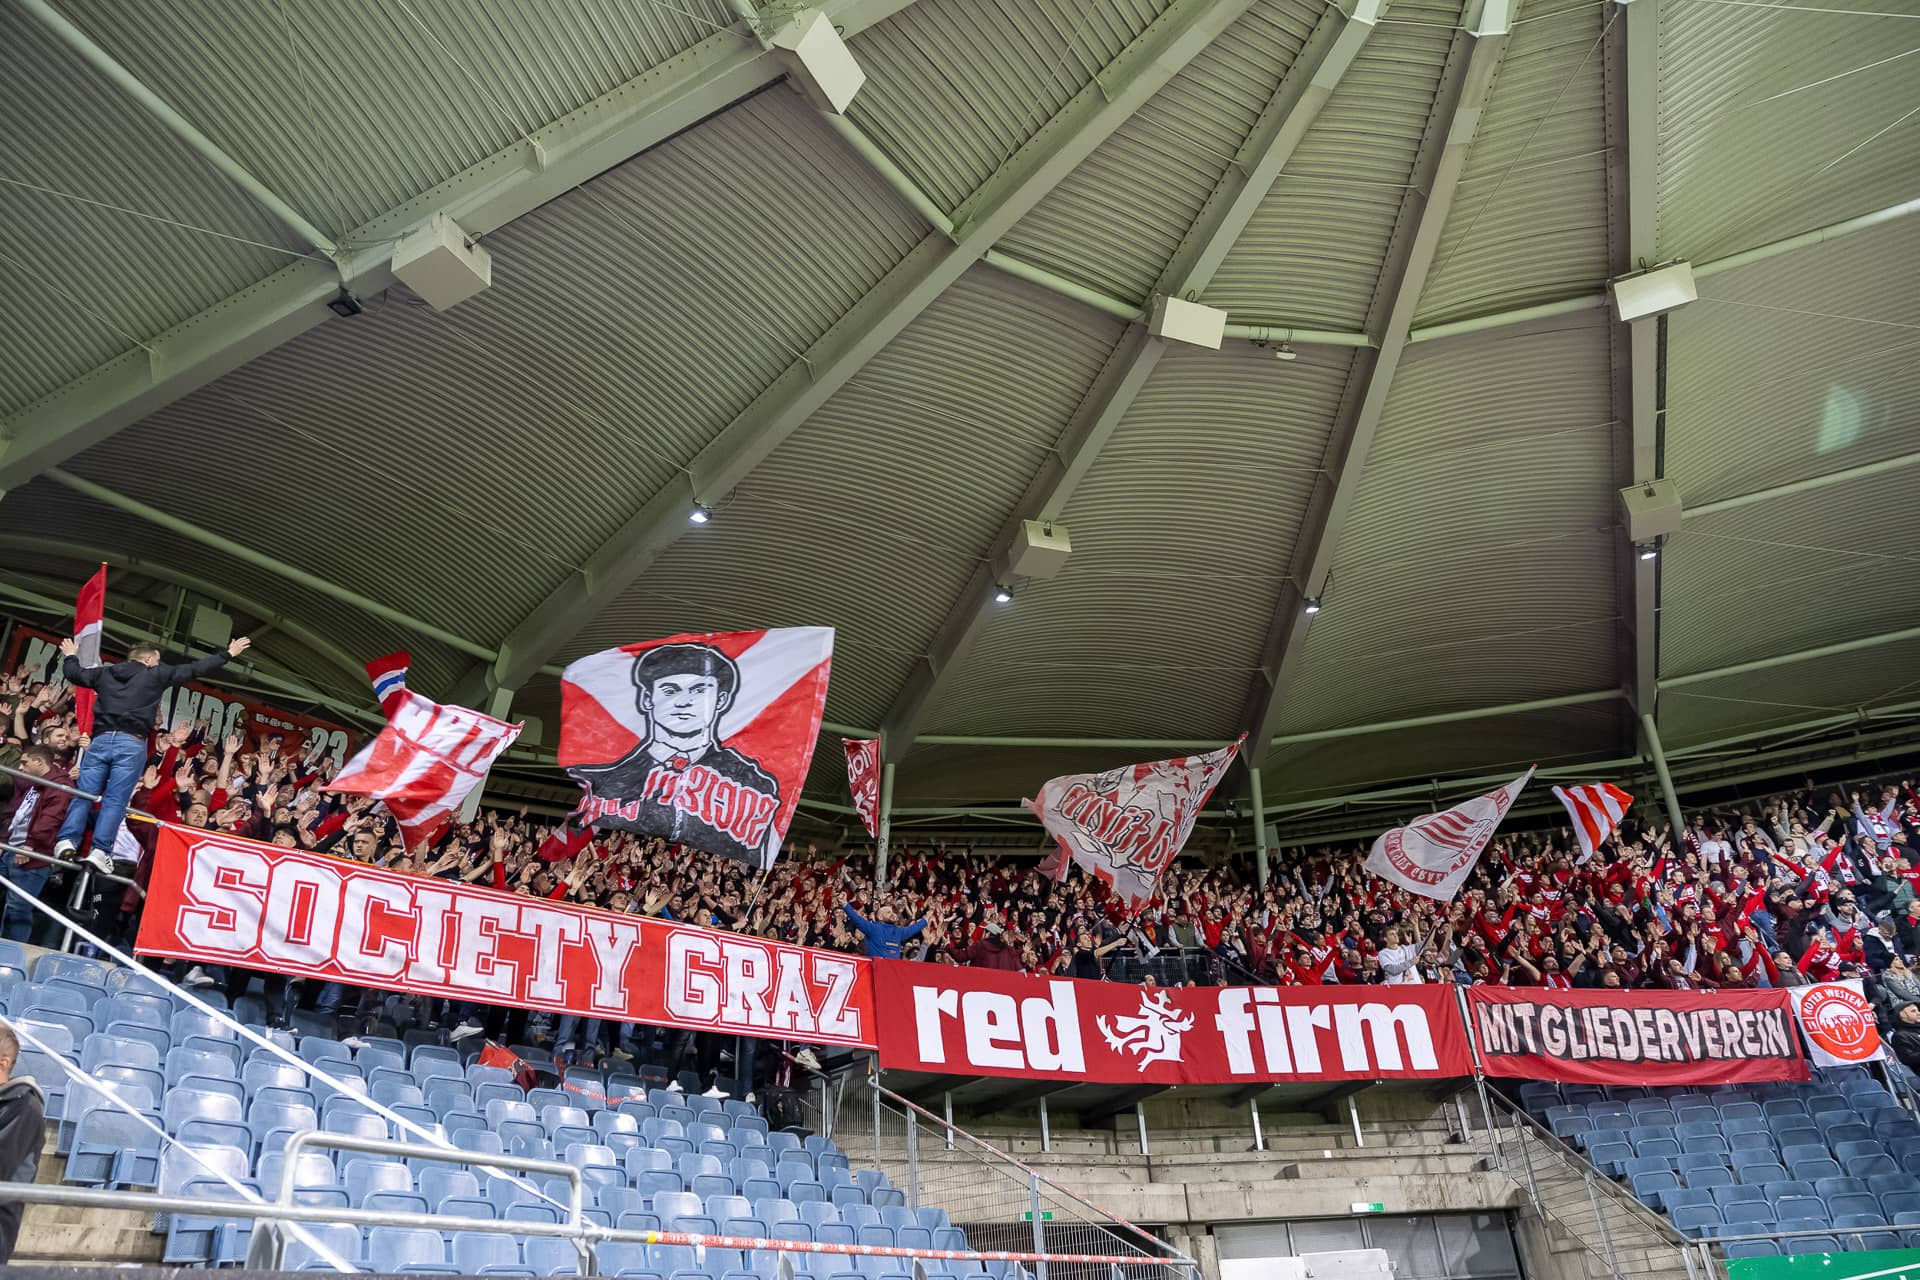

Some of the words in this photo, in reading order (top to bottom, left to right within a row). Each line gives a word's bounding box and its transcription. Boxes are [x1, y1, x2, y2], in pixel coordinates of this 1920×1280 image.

[177, 842, 640, 1011] SOCIETY
[666, 930, 861, 1038] GRAZ
[912, 981, 1087, 1073] red
[1214, 987, 1439, 1075] firm
[1823, 988, 1865, 1008] WESTEN
